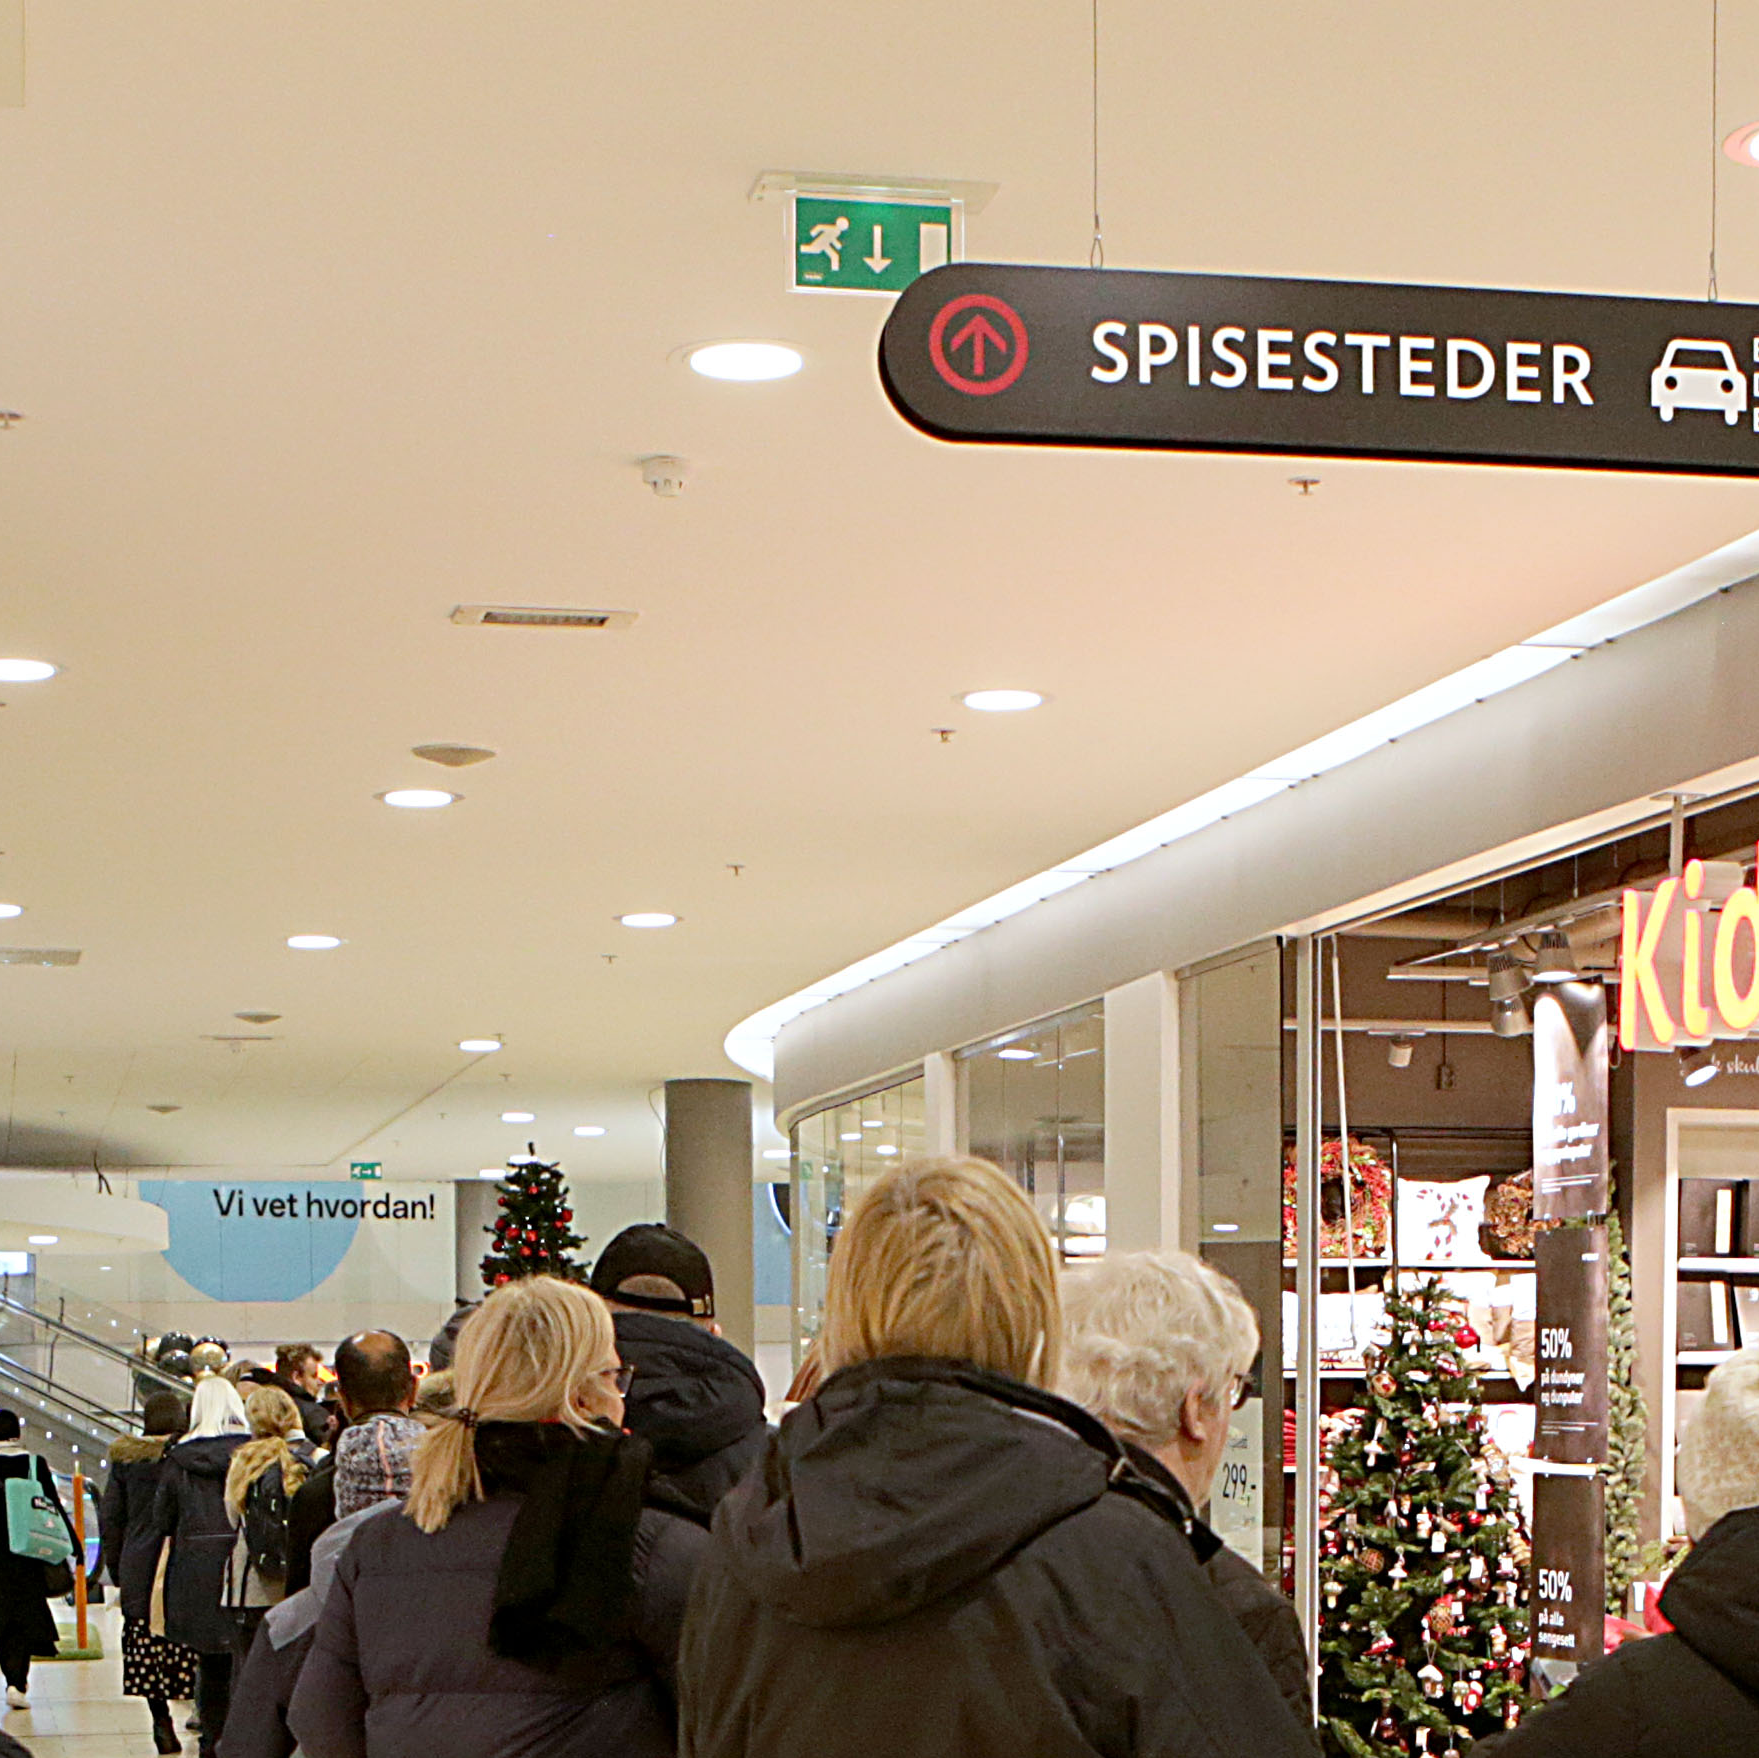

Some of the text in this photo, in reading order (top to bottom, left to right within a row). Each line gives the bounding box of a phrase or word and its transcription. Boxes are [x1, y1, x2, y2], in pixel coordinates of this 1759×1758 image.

[1090, 320, 1595, 406] SPISESTEDER
[213, 1188, 436, 1221] Vi vet hvordan!
[1540, 1327, 1573, 1360] 50%
[1538, 1568, 1573, 1603] 50%
[1538, 1607, 1565, 1628] på alle
[1538, 1631, 1576, 1649] sengesett
